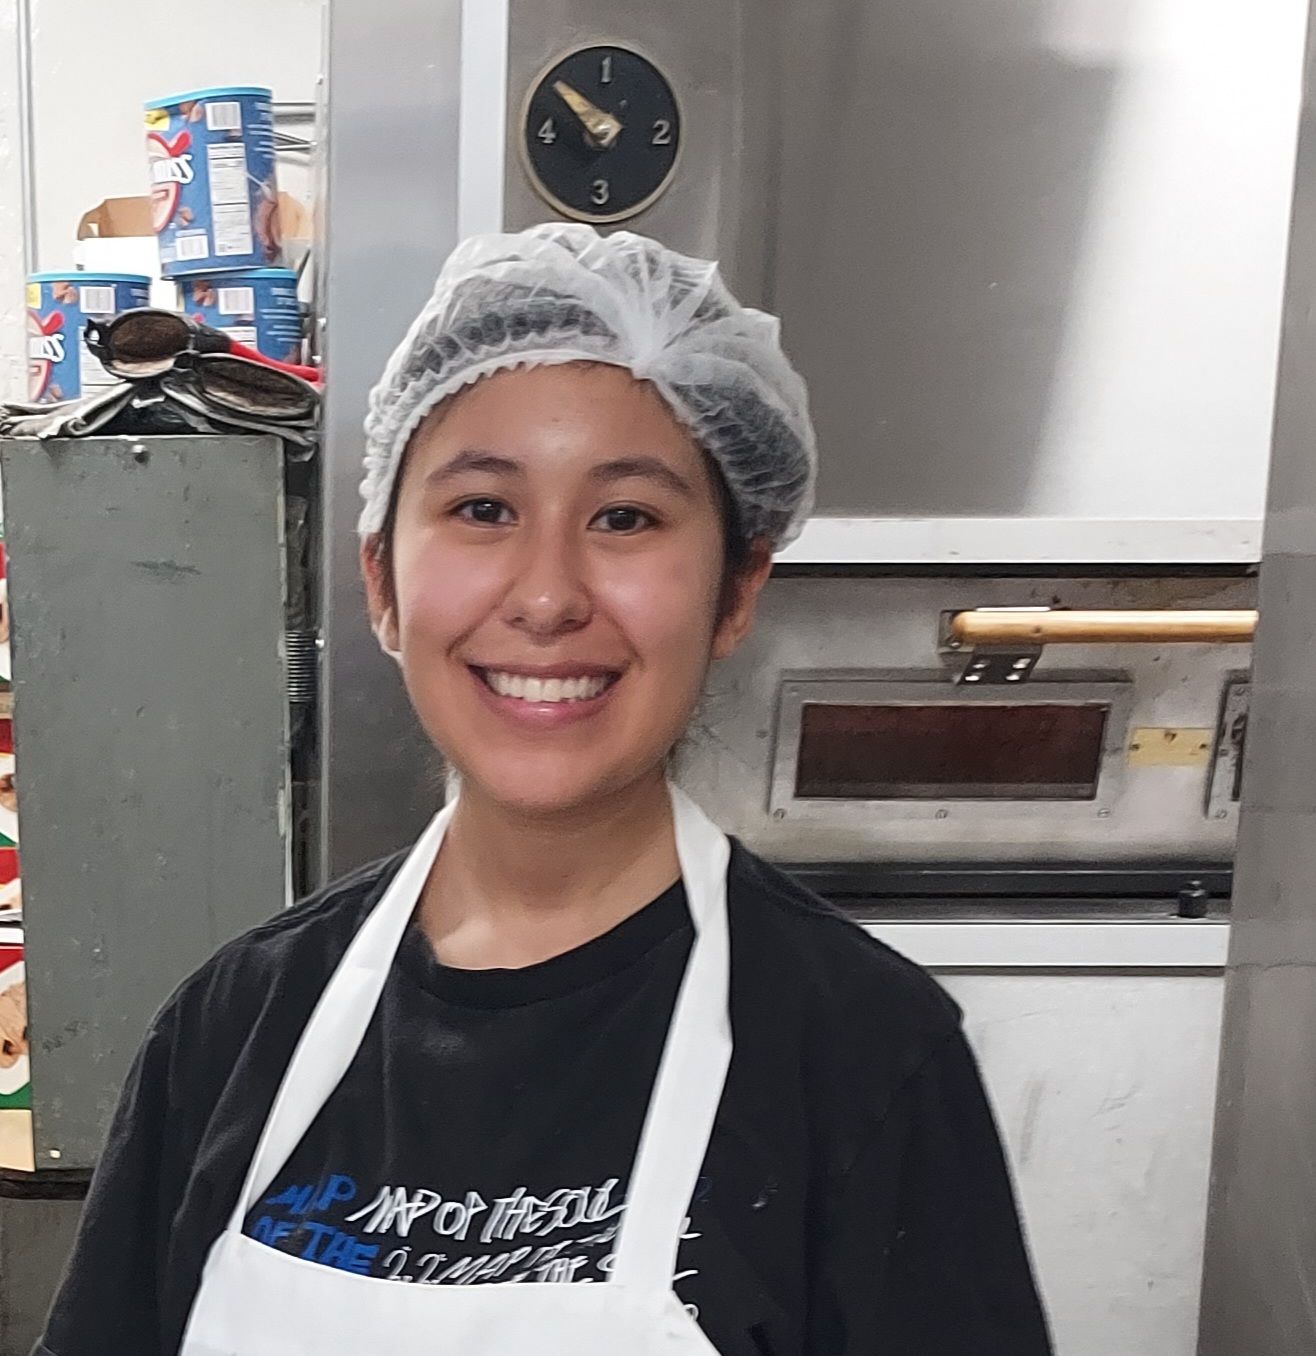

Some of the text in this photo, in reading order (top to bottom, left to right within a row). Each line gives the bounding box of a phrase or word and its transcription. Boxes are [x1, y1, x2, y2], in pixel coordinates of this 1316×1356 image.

[601, 56, 612, 83] 1
[537, 117, 556, 144] 4
[652, 119, 671, 145] 2
[591, 179, 609, 205] 3
[344, 1185, 442, 1237] MAP
[301, 1220, 380, 1274] THE
